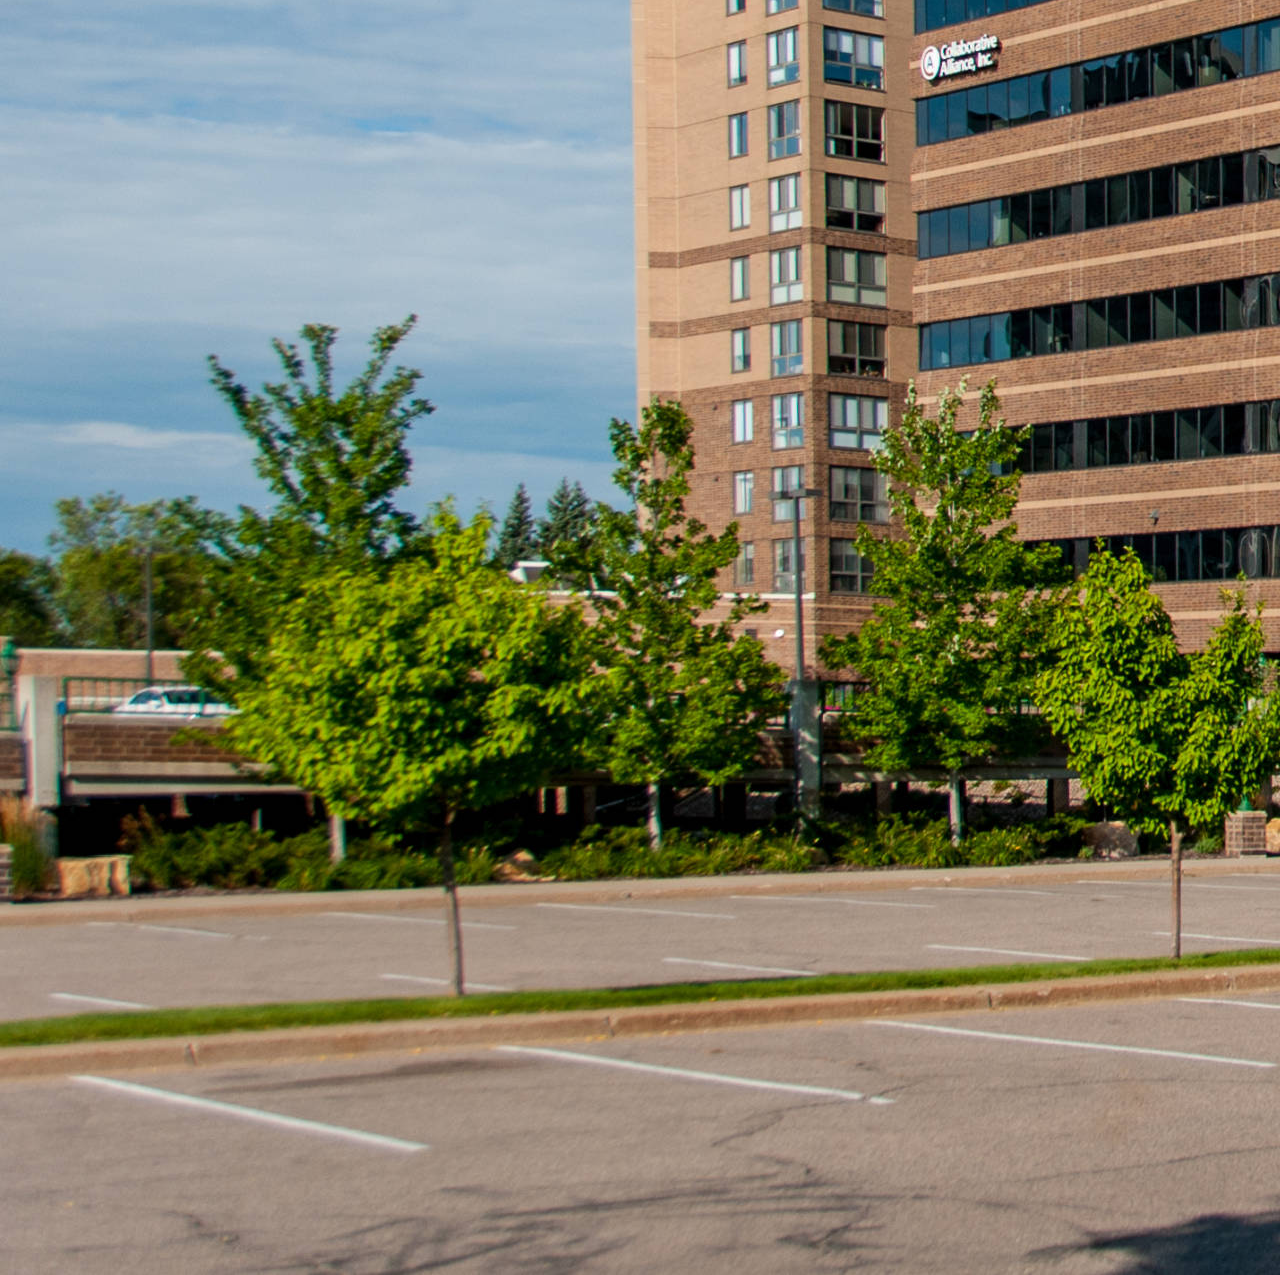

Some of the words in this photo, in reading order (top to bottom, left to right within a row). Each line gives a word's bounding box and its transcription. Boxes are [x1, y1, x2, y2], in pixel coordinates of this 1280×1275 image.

[941, 34, 998, 60] Collaborative
[940, 57, 976, 77] Alliance,
[977, 52, 993, 68] Inc.
